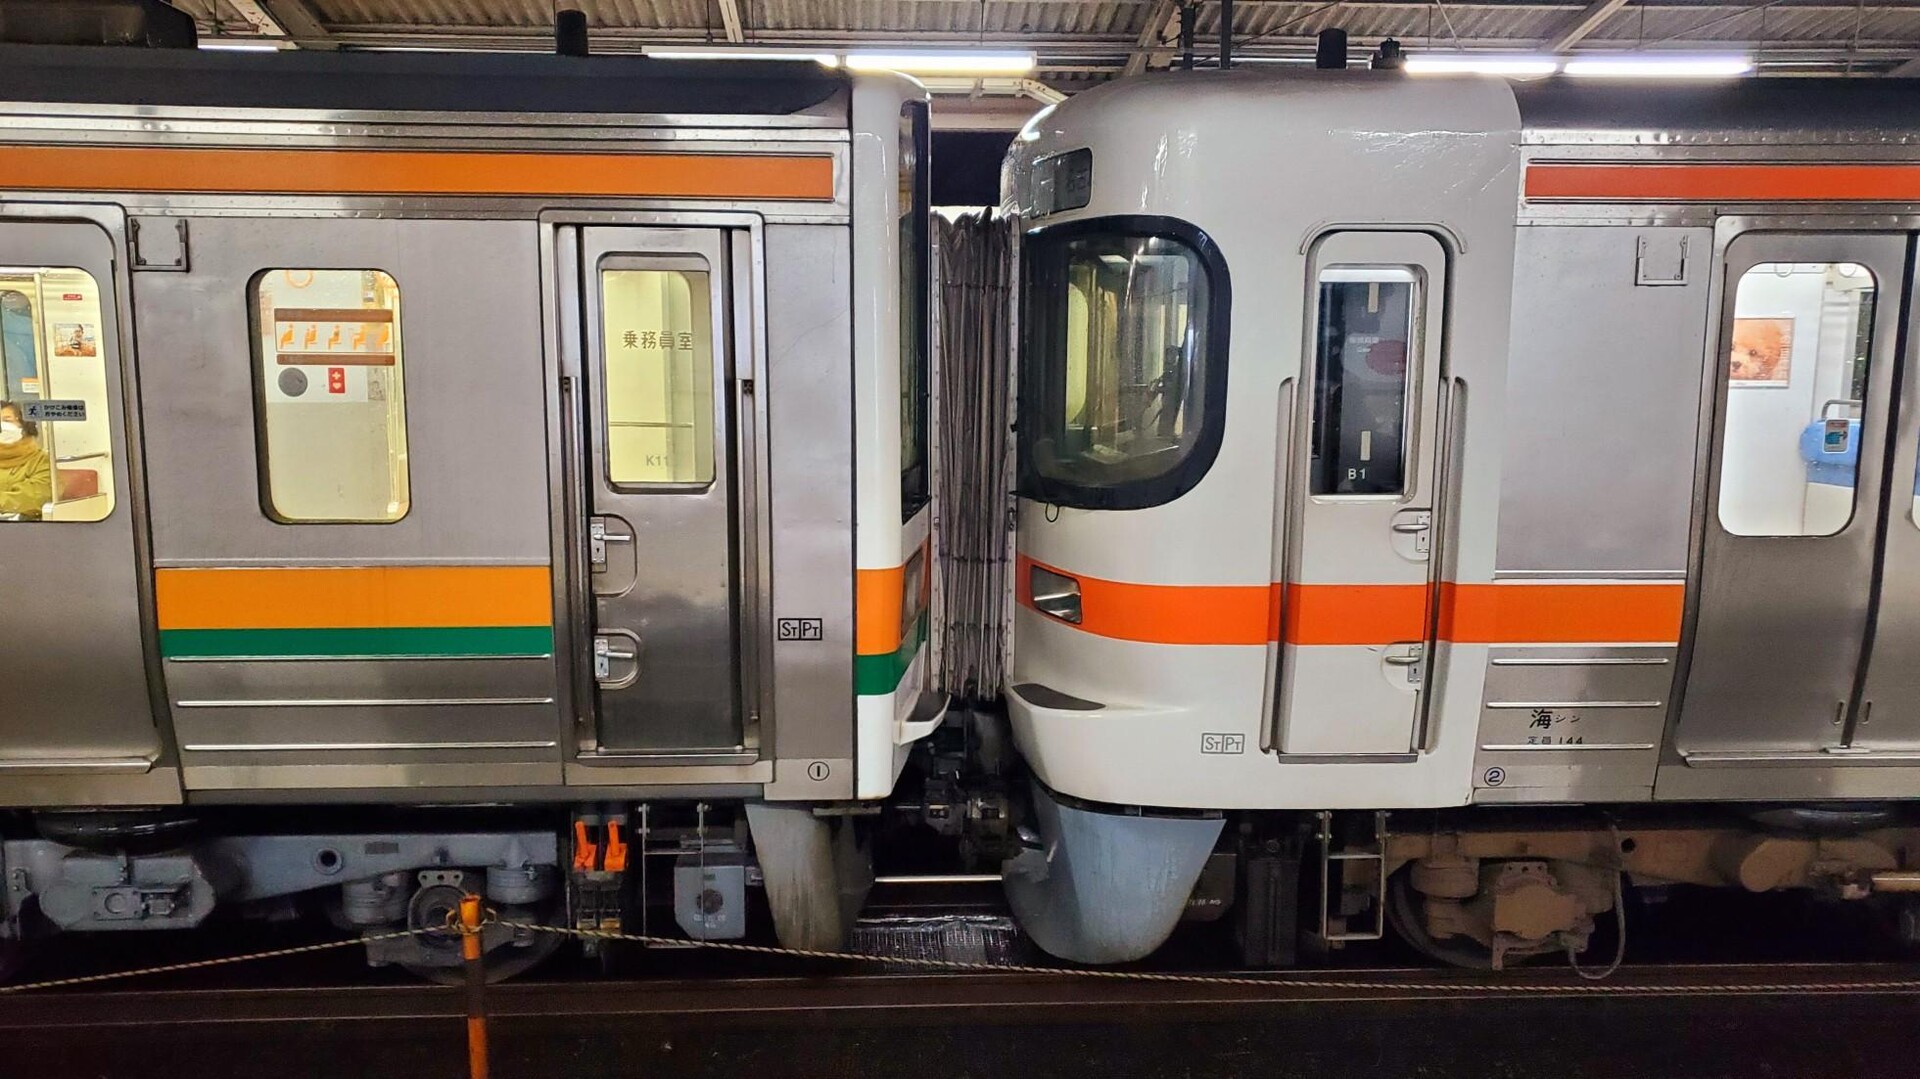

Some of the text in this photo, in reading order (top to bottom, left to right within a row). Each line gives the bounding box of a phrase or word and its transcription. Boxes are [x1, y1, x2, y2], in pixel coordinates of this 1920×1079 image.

[622, 330, 693, 350] 乗務員室
[646, 455, 668, 466] K11
[1559, 736, 1583, 745] 144
